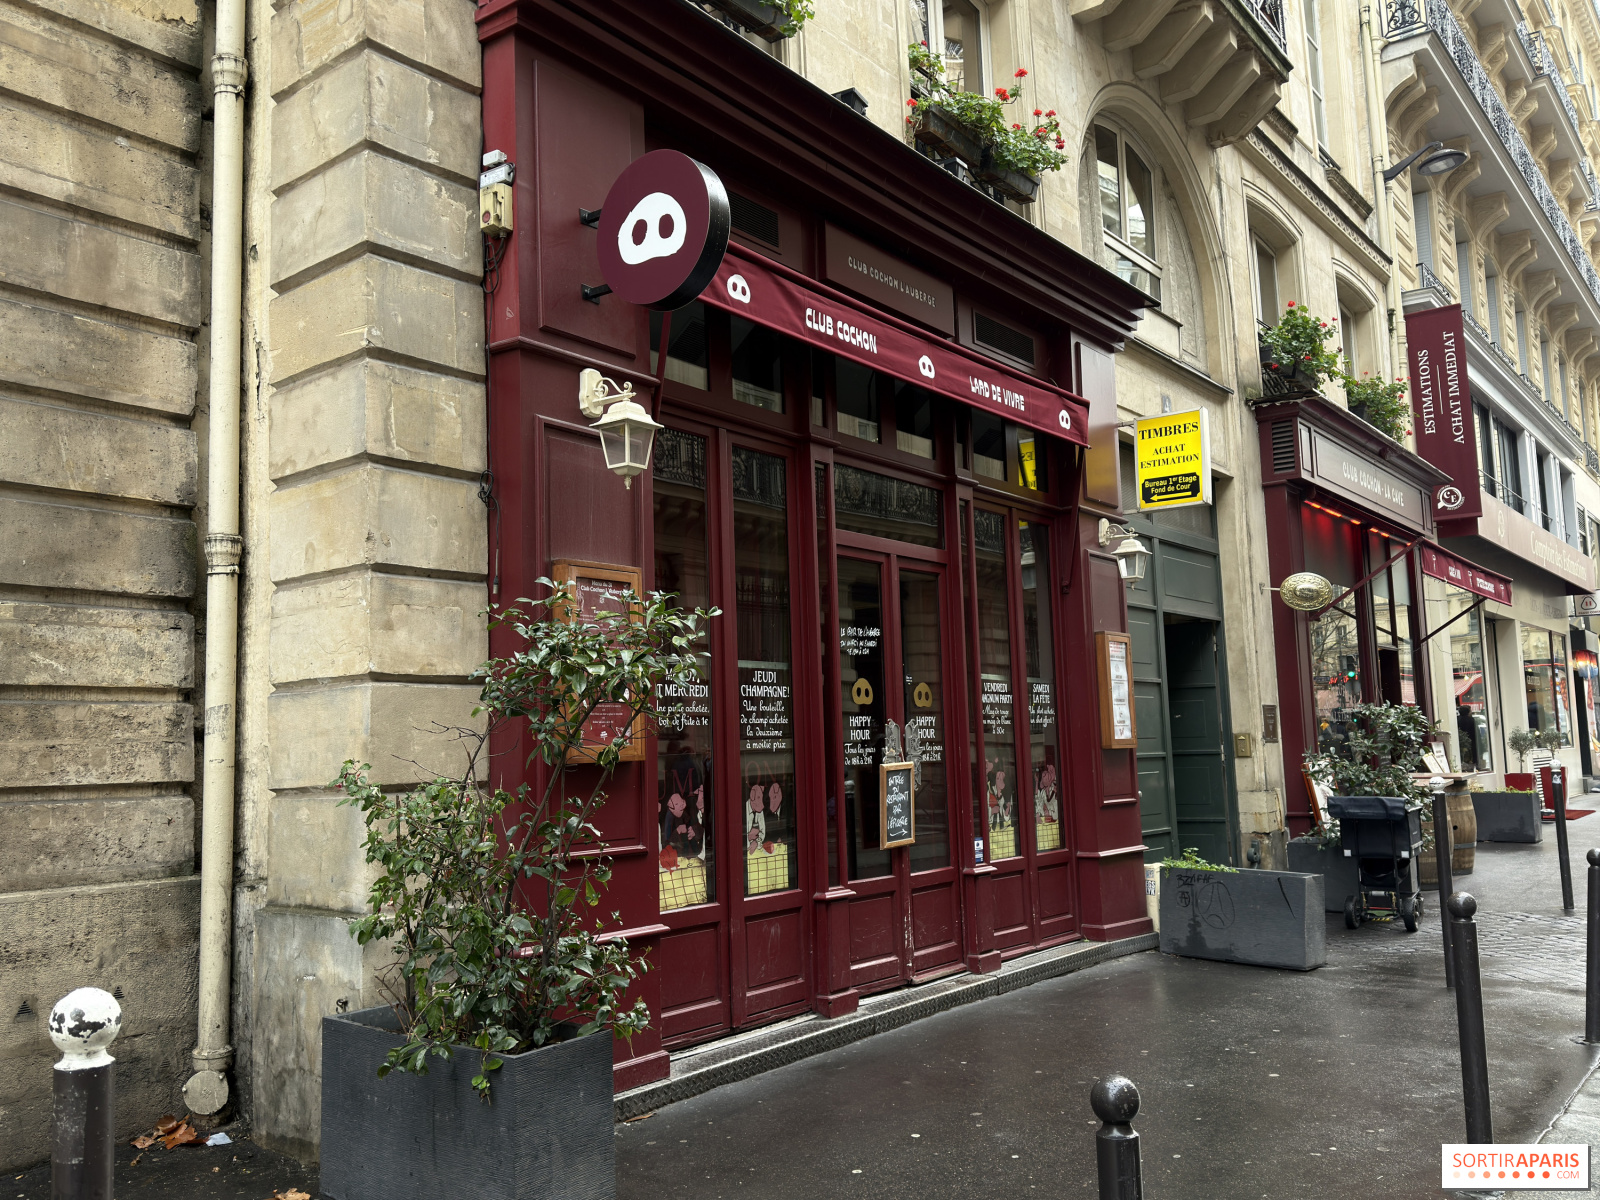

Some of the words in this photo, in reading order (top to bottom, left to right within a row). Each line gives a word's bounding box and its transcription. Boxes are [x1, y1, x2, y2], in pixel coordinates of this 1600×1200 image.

[848, 255, 868, 275] CLUB
[869, 266, 899, 290] COCHON
[805, 307, 834, 336] CLUB
[836, 320, 878, 354] COCHON
[1442, 331, 1460, 397] IMMEDIAT
[969, 375, 990, 398] LARD
[991, 383, 1002, 403] DE
[1003, 388, 1025, 412] VIVRE
[1418, 349, 1436, 435] ESTIMATIONS
[1449, 400, 1465, 444] ACHAT
[1138, 421, 1199, 440] TIMBRES
[1152, 443, 1186, 456] ACHAT
[1140, 453, 1200, 469] ESTIMATION
[1144, 480, 1168, 488] Bureau
[1178, 475, 1197, 484] Etage
[1342, 461, 1358, 483] CLUB
[1359, 470, 1382, 496] COCHON
[1151, 486, 1166, 494] Fond
[1176, 483, 1191, 491] Cour
[665, 667, 700, 684] MDI,
[752, 670, 777, 684] JEUDI
[664, 684, 709, 698] MERCREDI
[740, 684, 790, 698] CHAMPAGNE!
[983, 682, 1008, 693] VENDREDI
[1032, 684, 1050, 693] SAMEDI
[999, 694, 1013, 704] PARTY
[1032, 695, 1040, 703] LA
[667, 705, 684, 715] pie
[742, 700, 758, 712] Une
[759, 700, 785, 712] bouteille
[740, 714, 748, 724] de
[849, 716, 872, 727] HAPPY
[916, 715, 937, 727] HAPPY
[746, 725, 754, 737] la
[755, 727, 783, 737] deuxième
[850, 729, 871, 741] HOUR
[917, 728, 936, 739] HOUR
[752, 739, 772, 749] moitié
[772, 738, 787, 752] prix
[843, 742, 858, 755] Tous
